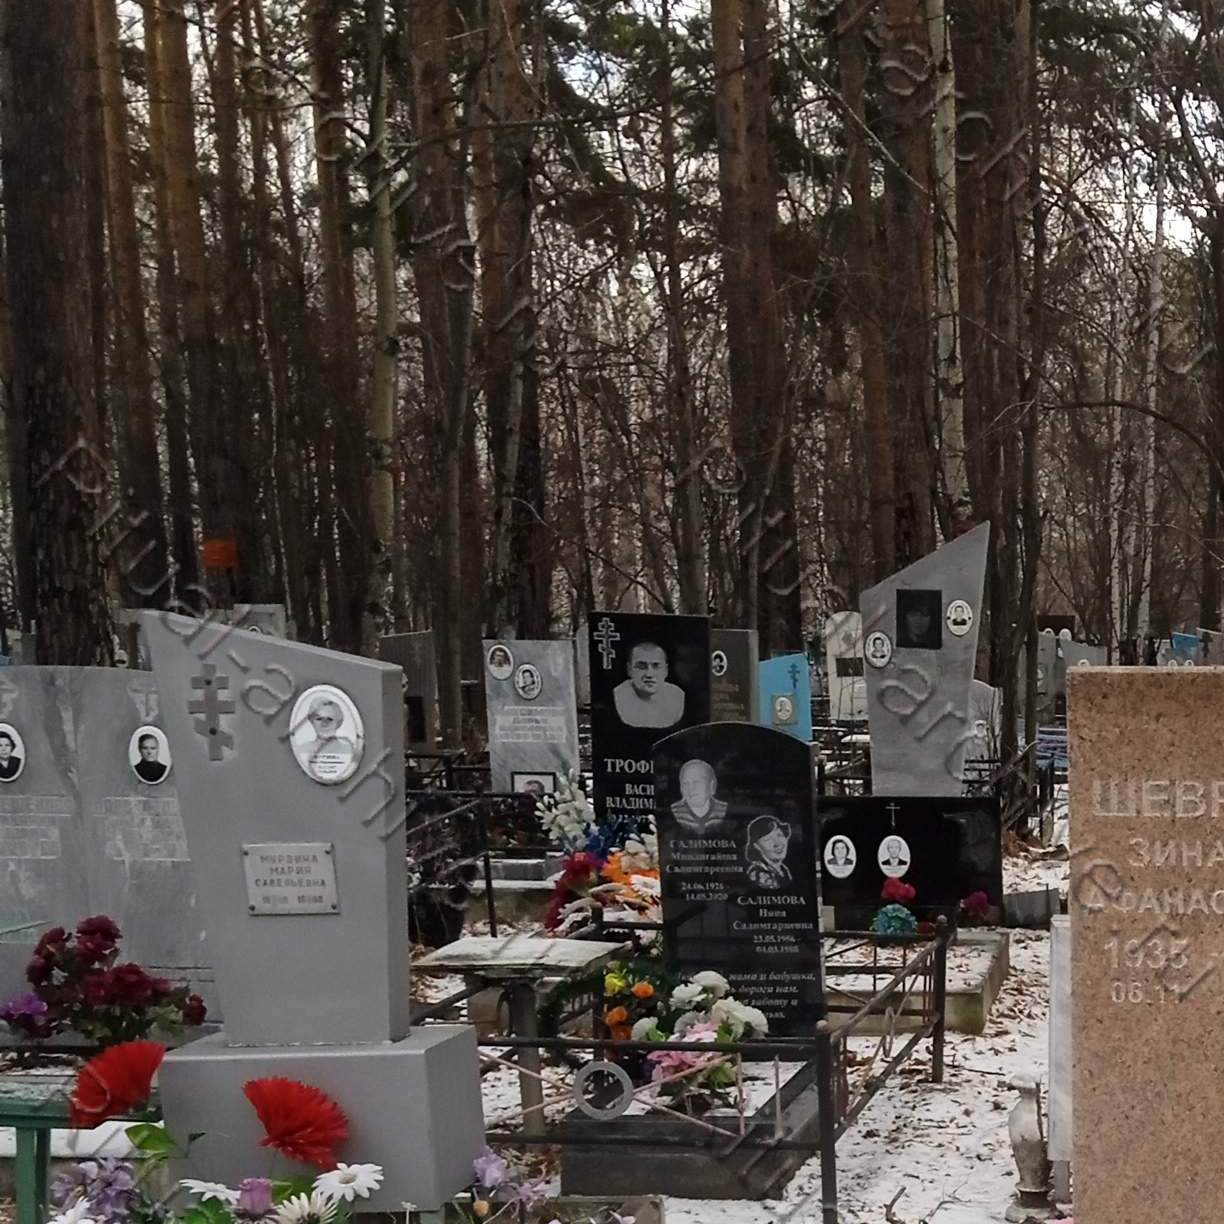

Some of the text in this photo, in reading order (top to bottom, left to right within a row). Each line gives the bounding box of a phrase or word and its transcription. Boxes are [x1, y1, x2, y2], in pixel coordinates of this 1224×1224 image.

[669, 839, 737, 849] САЛИМОВА
[259, 853, 319, 864] МУРЗИНА
[269, 865, 313, 876] МАРИЯ
[736, 895, 806, 906] САЛИМОВА
[1103, 937, 1190, 970] 1935
